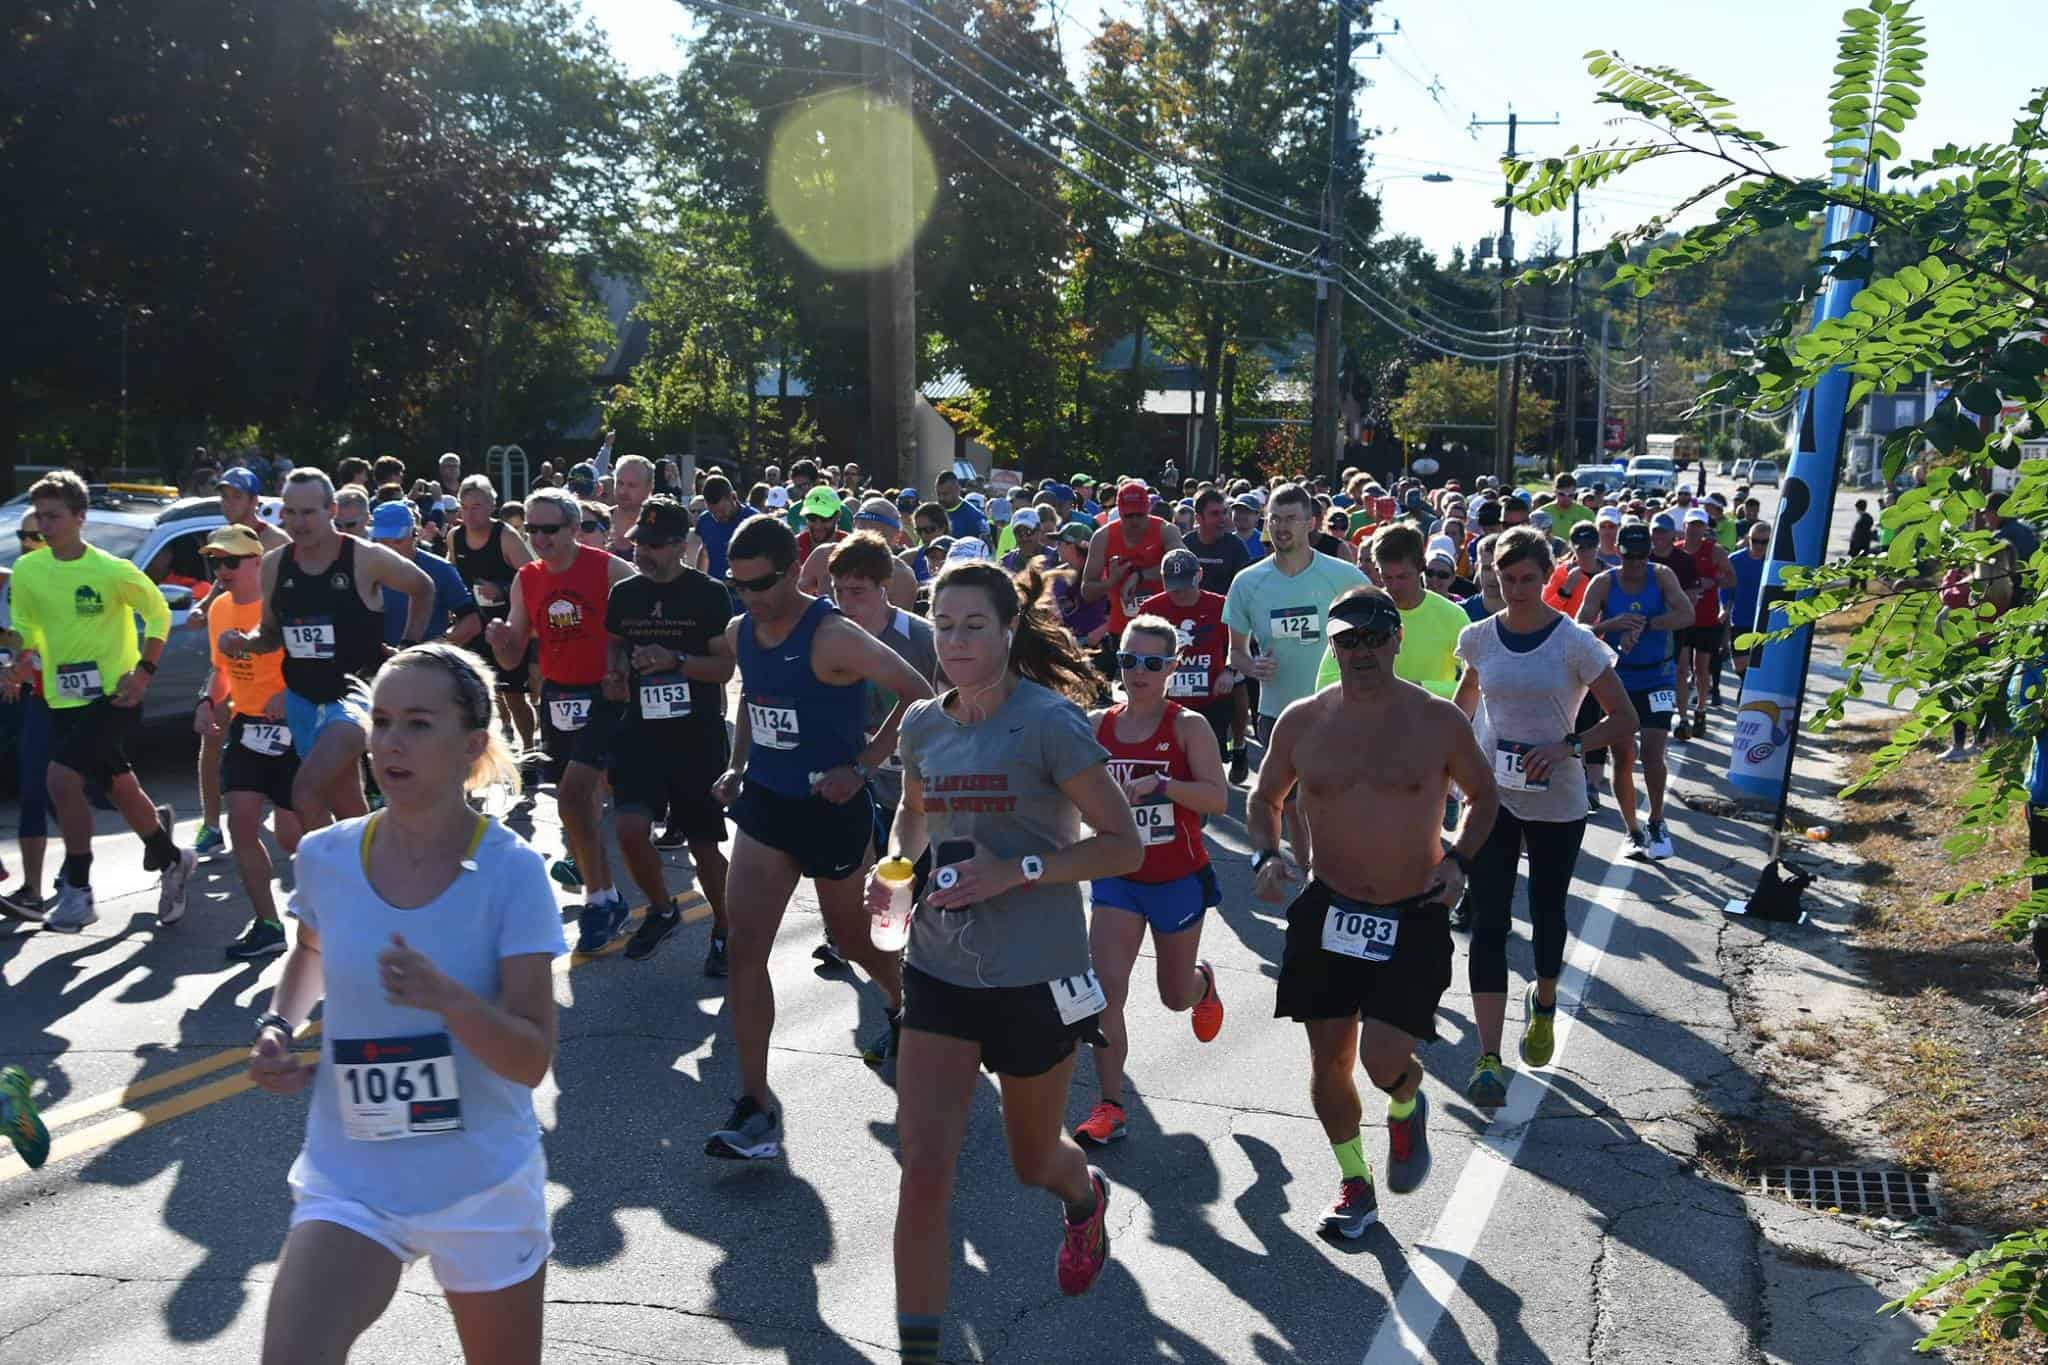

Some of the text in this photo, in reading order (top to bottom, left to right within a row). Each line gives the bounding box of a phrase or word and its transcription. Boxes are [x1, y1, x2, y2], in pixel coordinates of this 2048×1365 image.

[1281, 617, 1310, 632] 122
[292, 628, 324, 643] 182
[60, 673, 89, 689] 201
[1173, 673, 1203, 686] 1151
[643, 686, 685, 703] 1153
[751, 707, 792, 730] 1134
[255, 726, 281, 741] 174
[1505, 754, 1526, 773] 15
[1334, 911, 1393, 941] 1083
[344, 1062, 439, 1105] 1061
